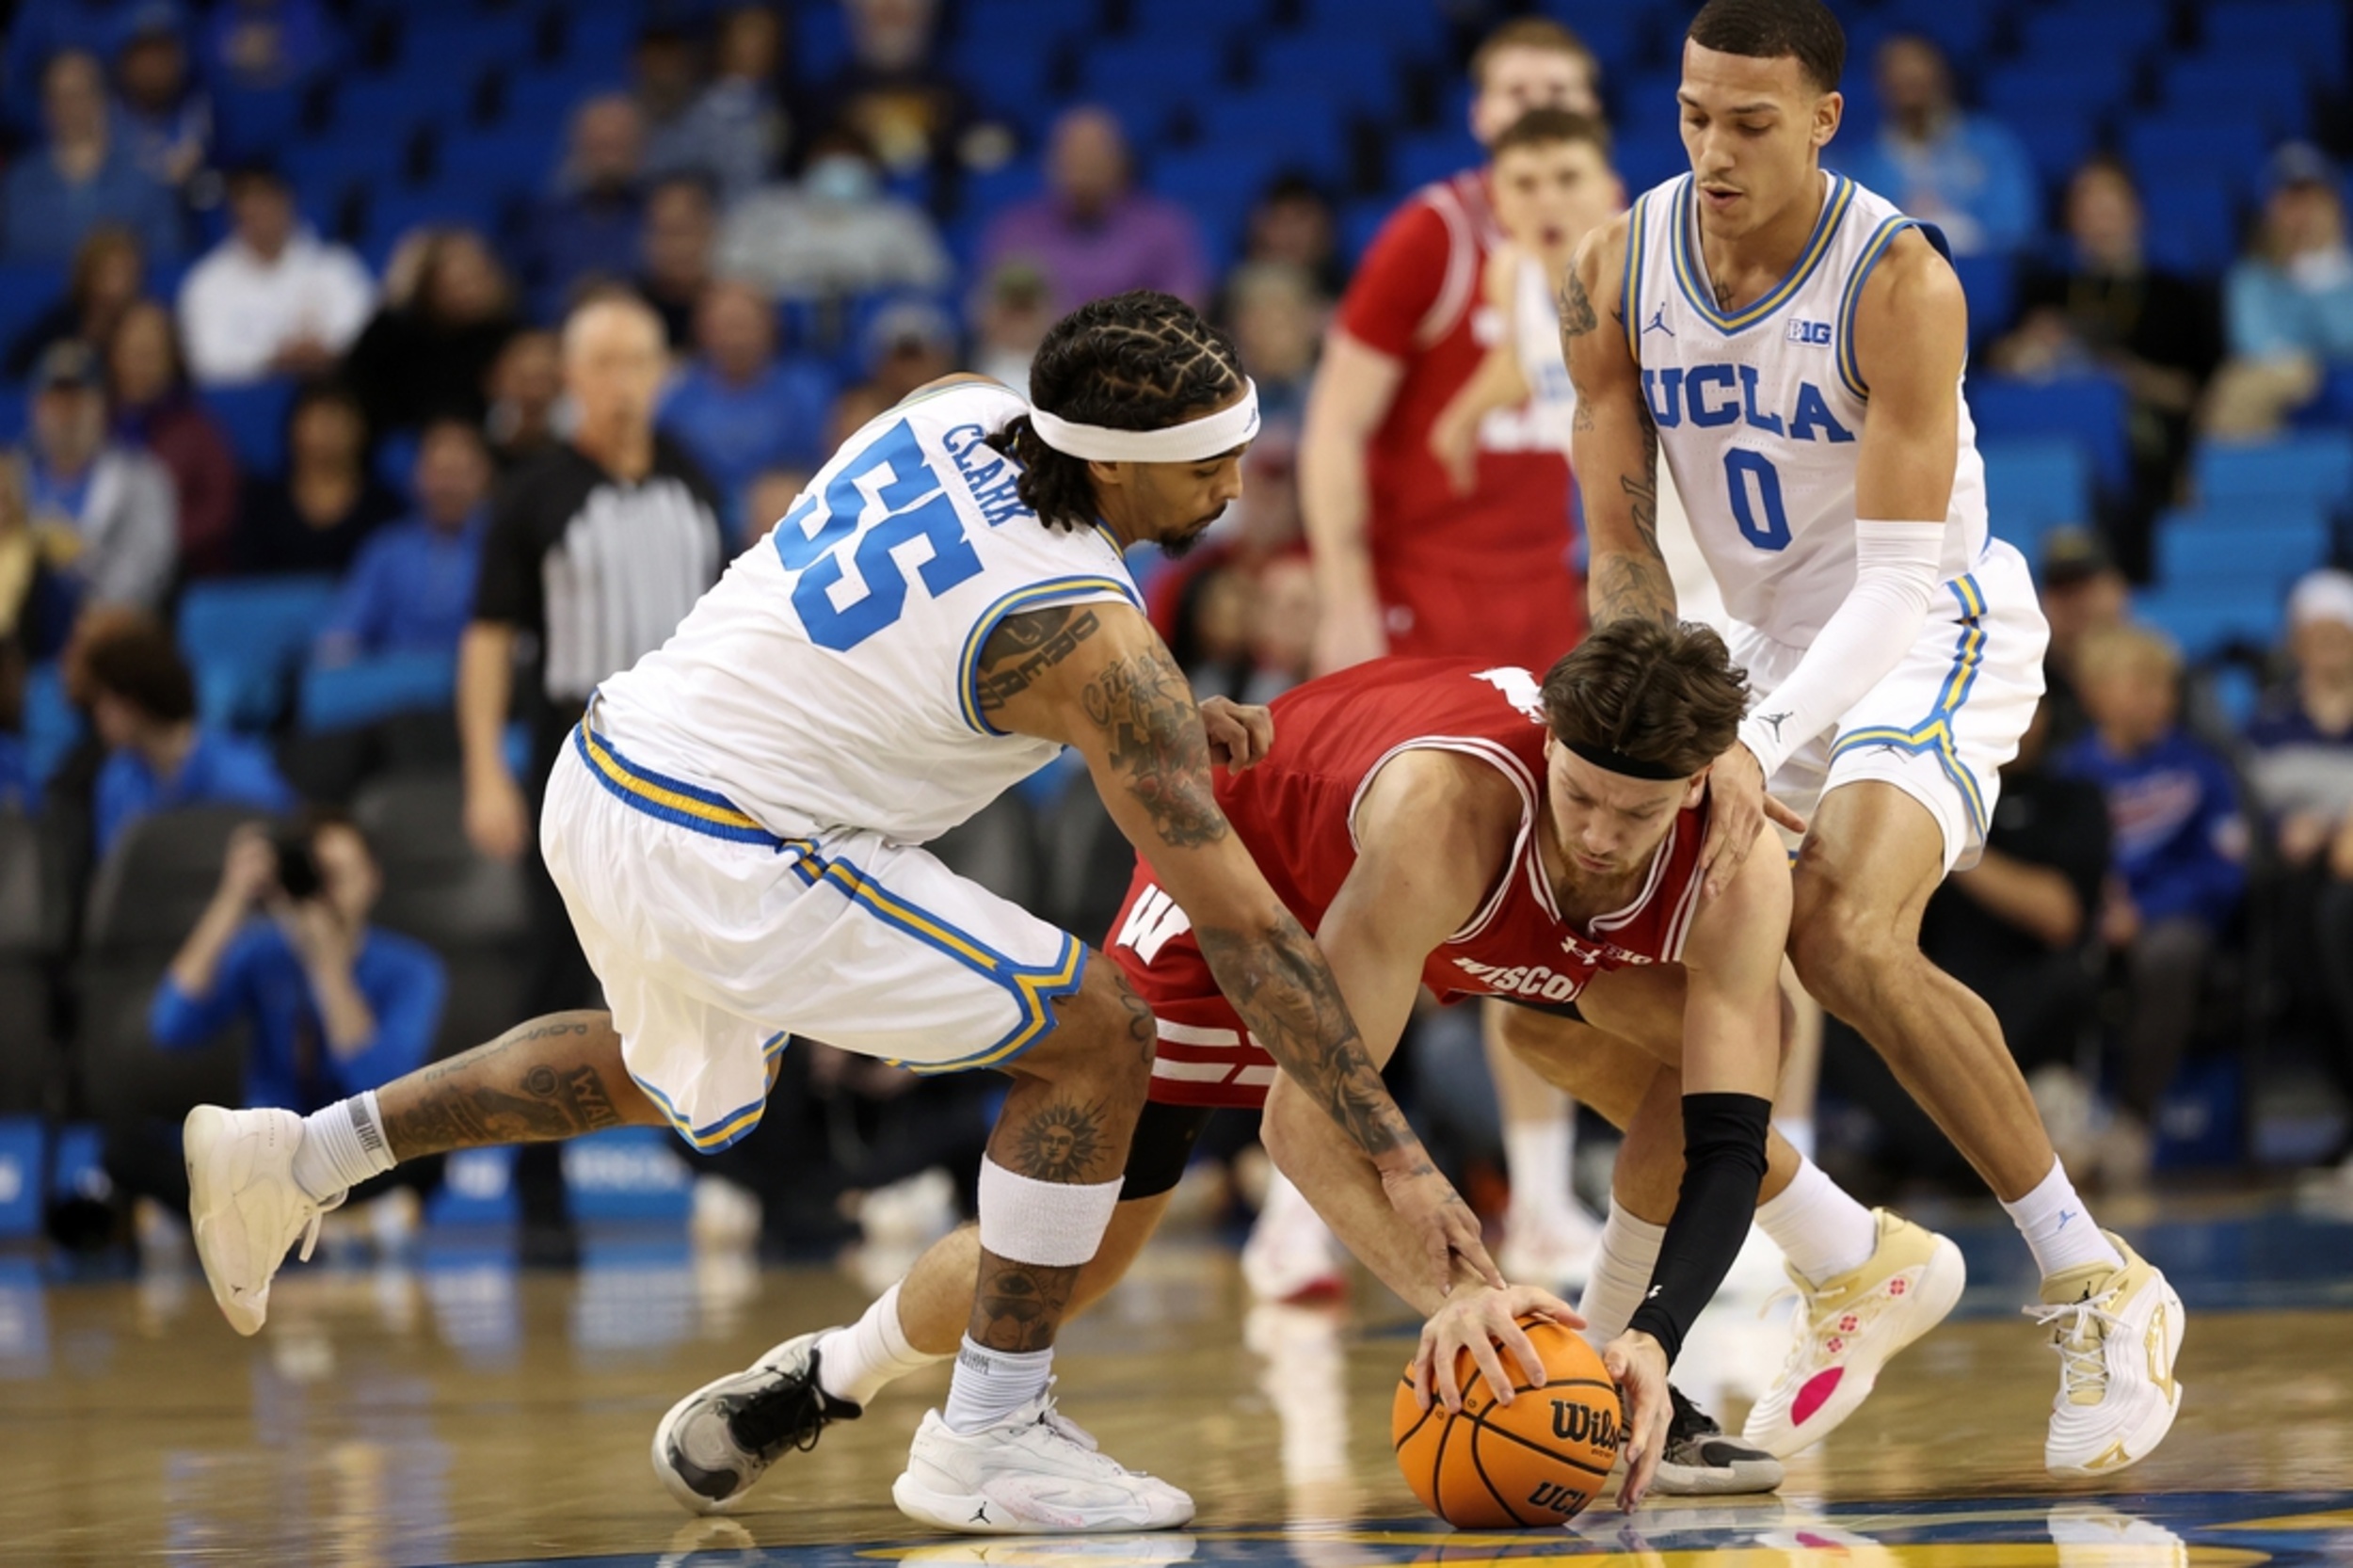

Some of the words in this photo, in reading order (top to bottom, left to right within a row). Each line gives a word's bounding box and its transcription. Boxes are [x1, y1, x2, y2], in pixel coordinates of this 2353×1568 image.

[1641, 362, 1856, 443] UCLA
[942, 423, 1036, 528] CLARK
[1723, 446, 1793, 552] 0
[773, 416, 985, 653] 55
[1114, 882, 1193, 968] W
[1450, 956, 1586, 1004] WISCO
